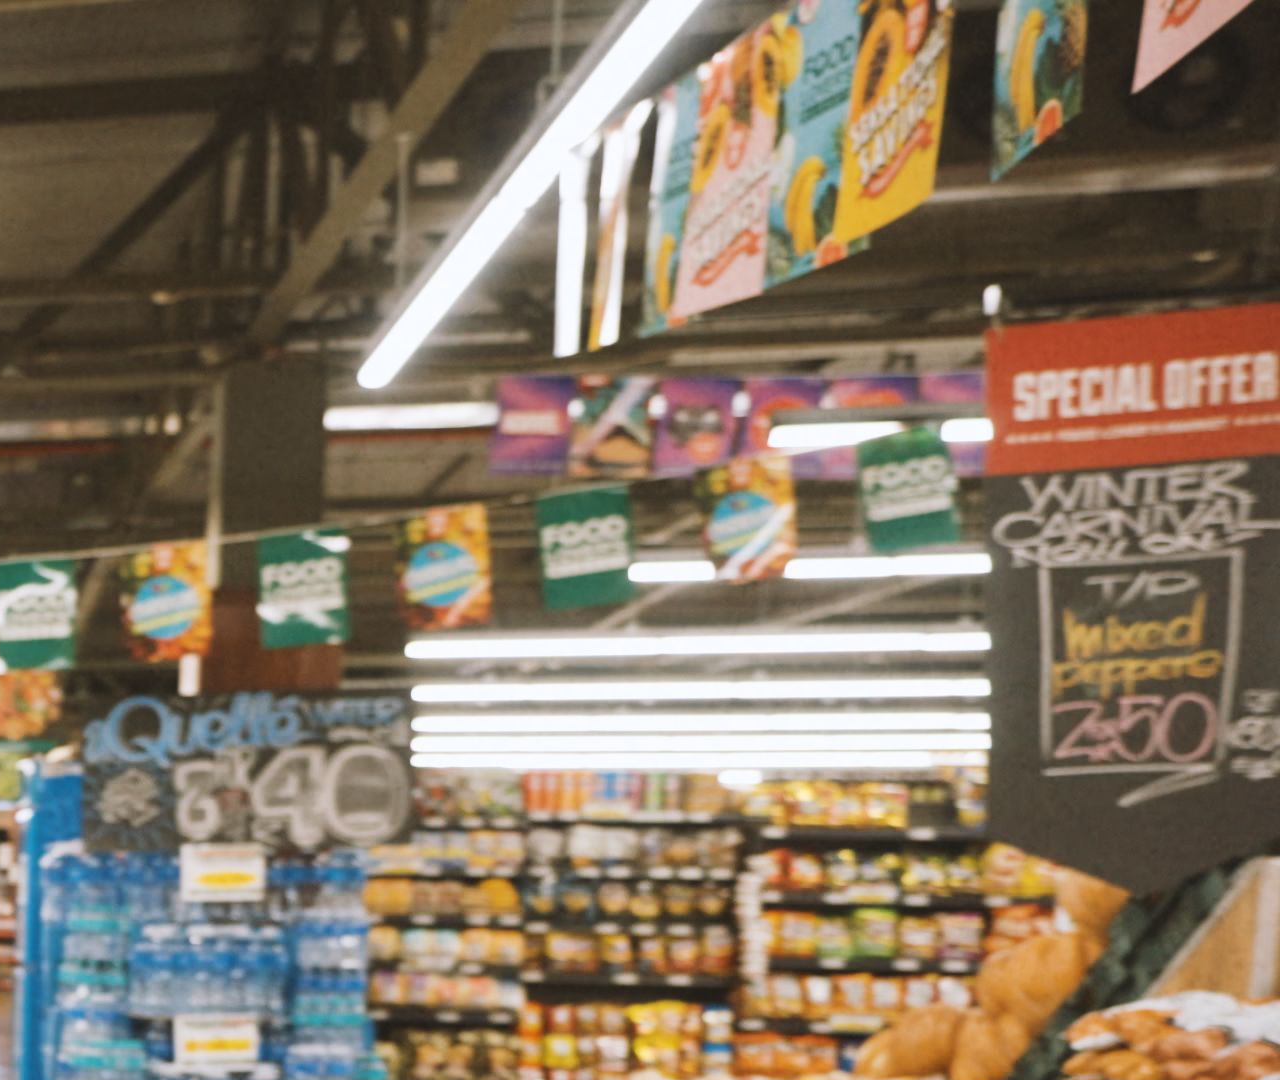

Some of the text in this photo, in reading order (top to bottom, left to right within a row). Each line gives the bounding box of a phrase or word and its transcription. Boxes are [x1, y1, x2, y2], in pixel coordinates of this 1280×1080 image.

[1012, 352, 1279, 422] SPECIAL OFFER
[1019, 463, 1258, 514] WINTER
[992, 498, 1280, 548] CARNIVAL
